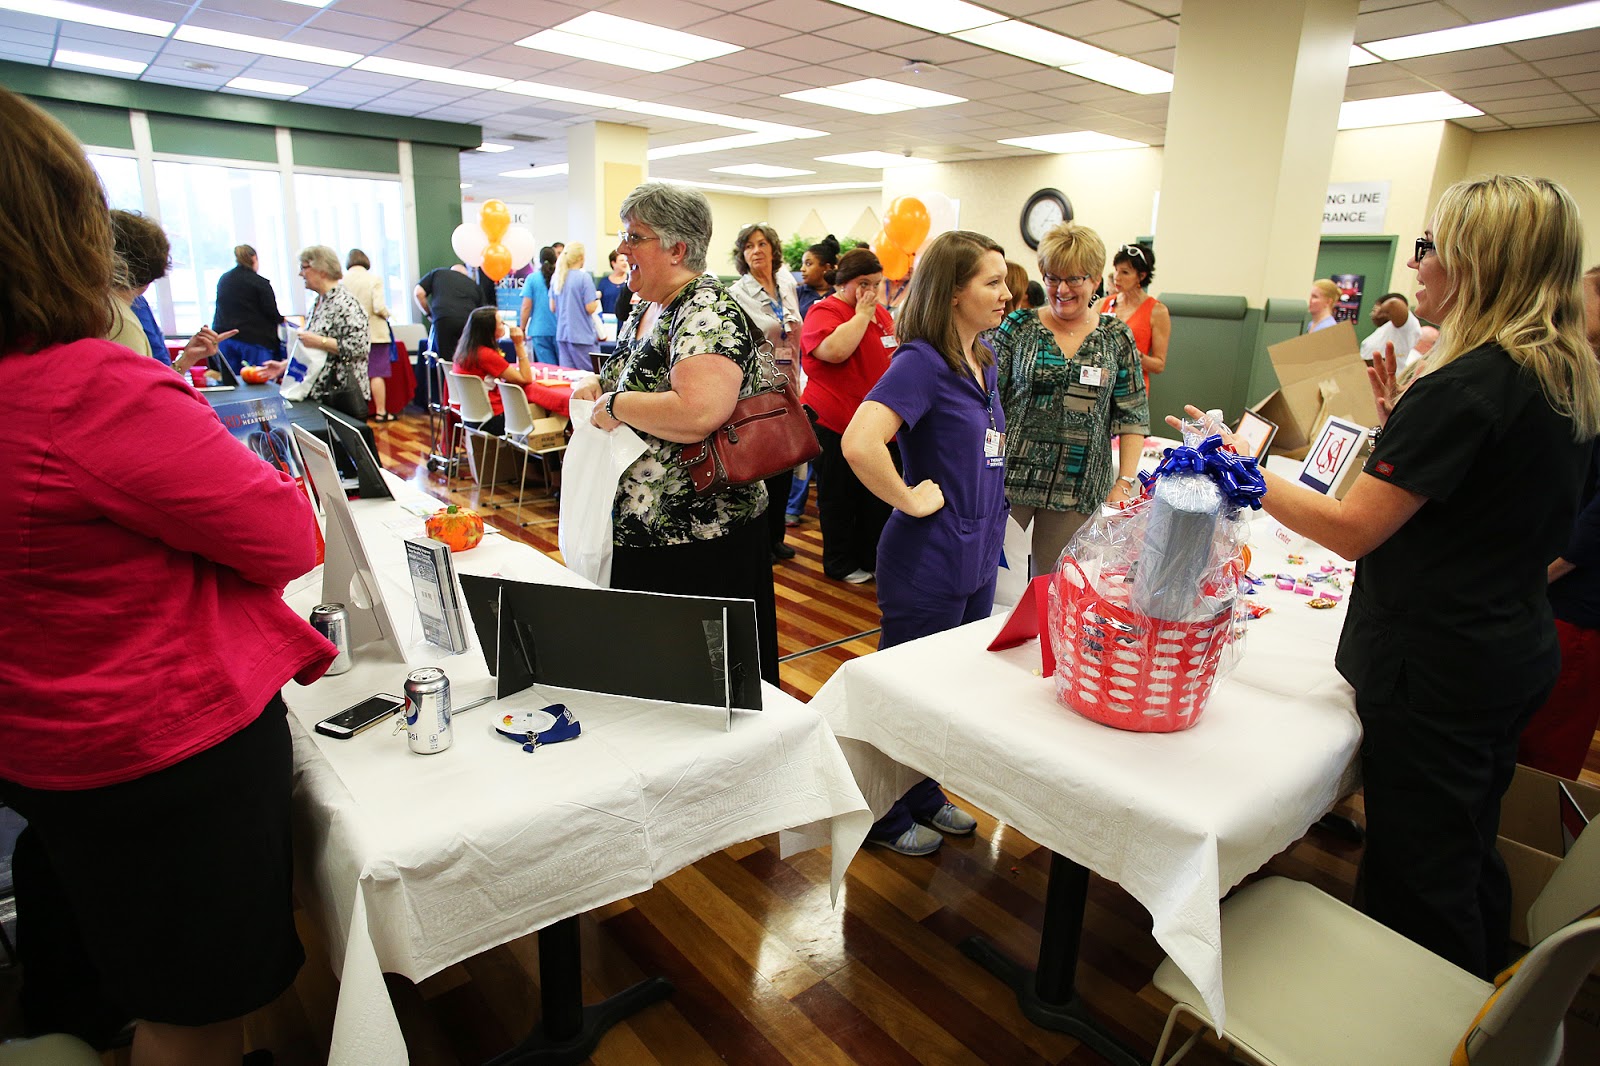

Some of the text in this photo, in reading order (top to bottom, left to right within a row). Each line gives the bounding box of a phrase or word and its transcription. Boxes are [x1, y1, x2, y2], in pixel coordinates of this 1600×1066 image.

[1326, 192, 1381, 205] NG LINE
[1322, 211, 1367, 222] RANCE
[1275, 527, 1291, 545] Center
